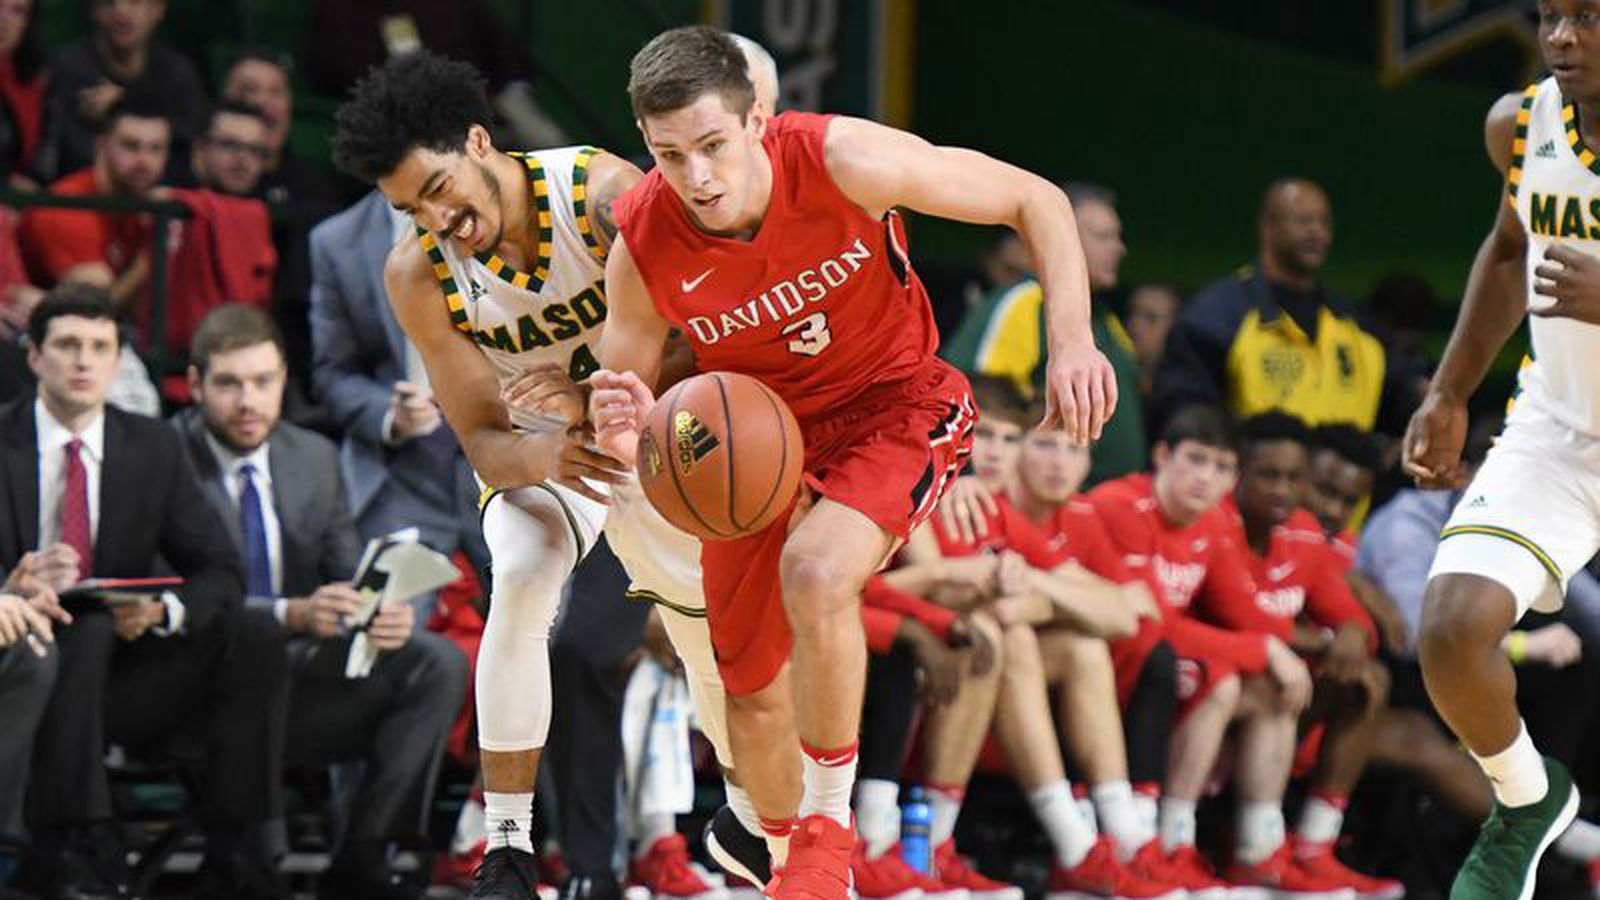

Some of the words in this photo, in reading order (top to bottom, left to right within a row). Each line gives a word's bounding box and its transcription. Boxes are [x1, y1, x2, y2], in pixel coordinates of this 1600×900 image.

[687, 238, 873, 345] DAVIDSON
[780, 310, 832, 357] 3
[568, 342, 601, 383] 4
